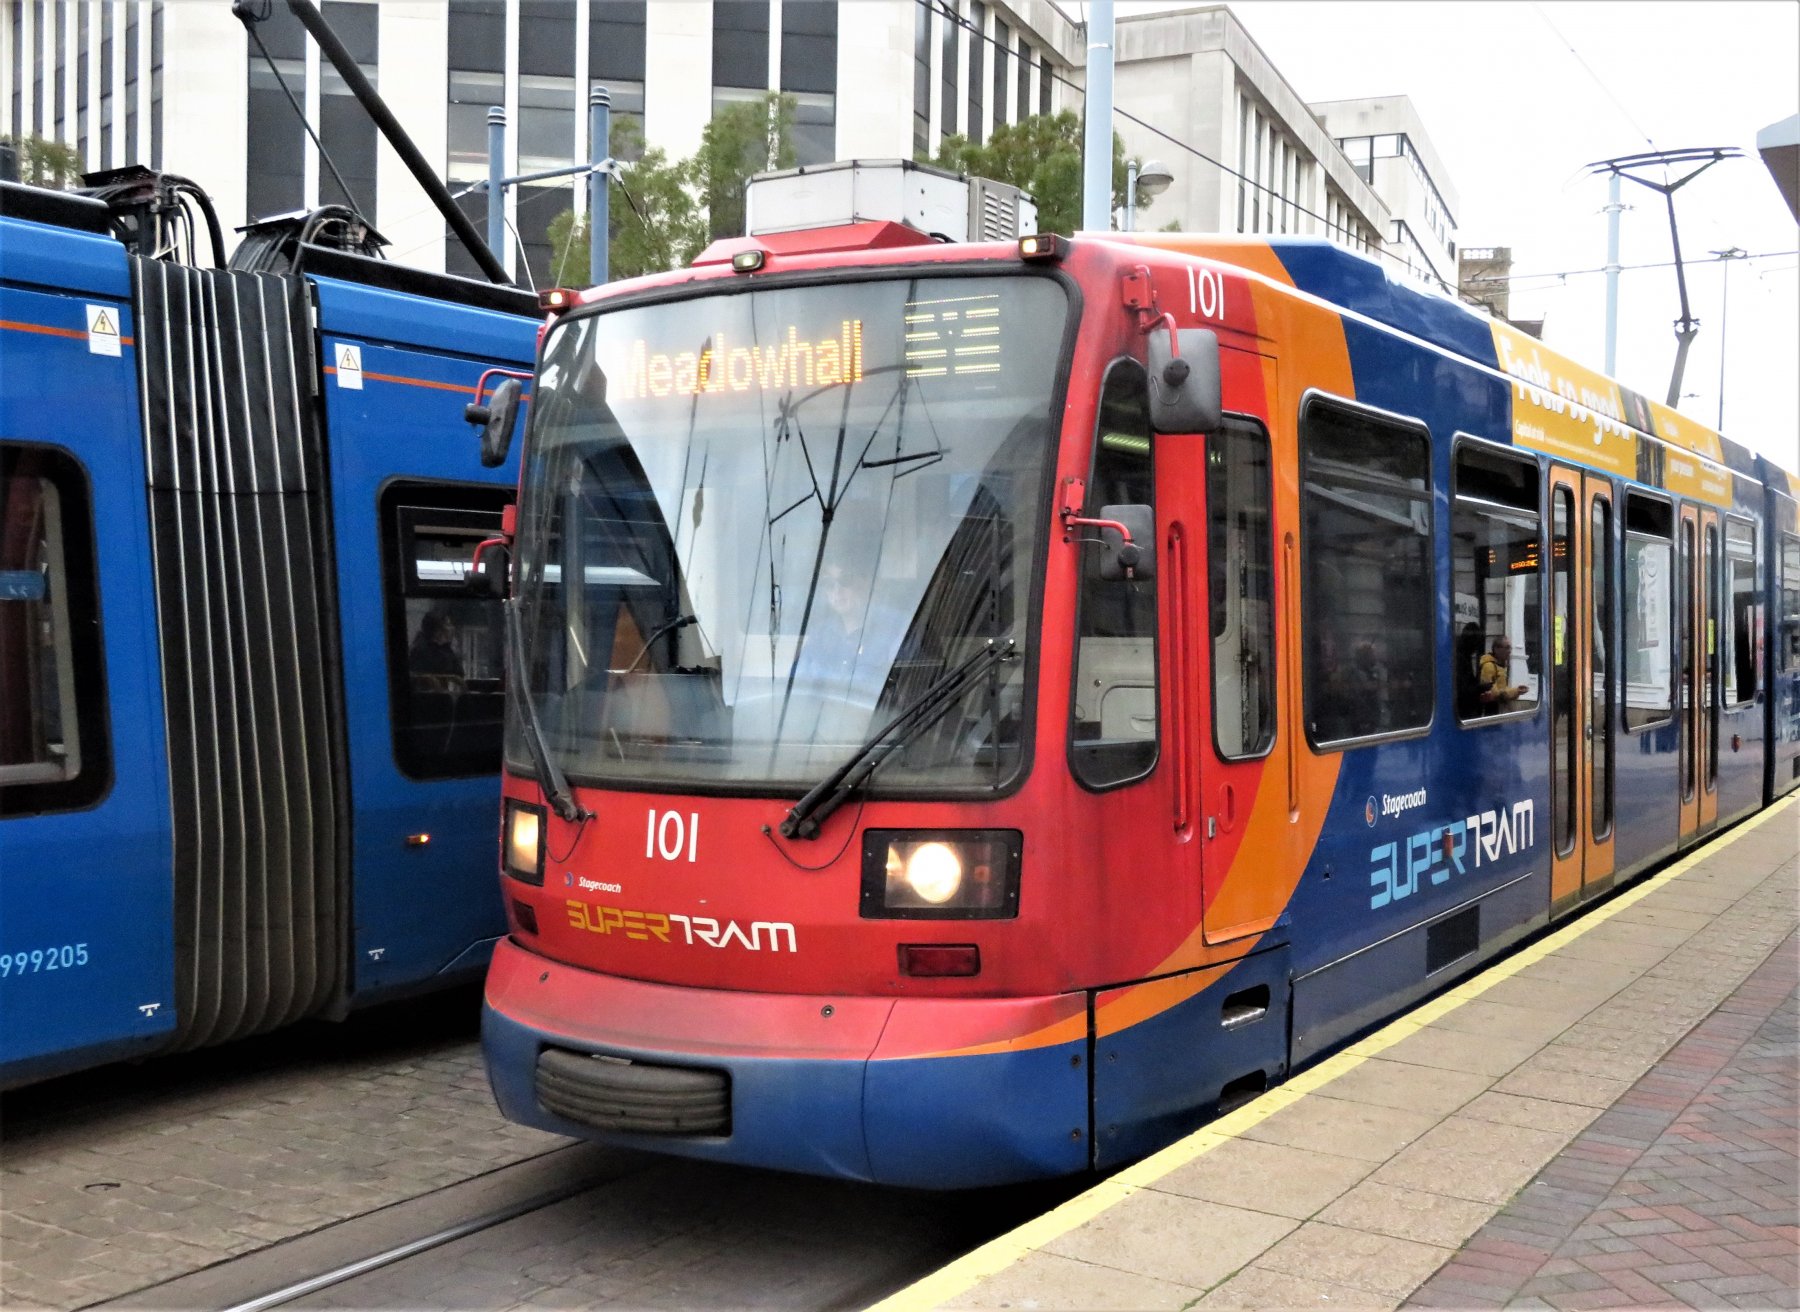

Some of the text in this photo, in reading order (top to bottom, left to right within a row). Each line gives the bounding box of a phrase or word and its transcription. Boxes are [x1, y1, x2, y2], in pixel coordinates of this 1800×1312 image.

[1186, 264, 1224, 321] 101
[614, 319, 864, 402] Meadowhall
[1382, 786, 1427, 818] Stagecoach
[646, 808, 699, 863] 101
[1370, 798, 1535, 911] SUPERTRAM
[578, 876, 622, 894] Stagecoach
[566, 899, 797, 953] SUPERTRAM
[0, 942, 89, 978] 999205
